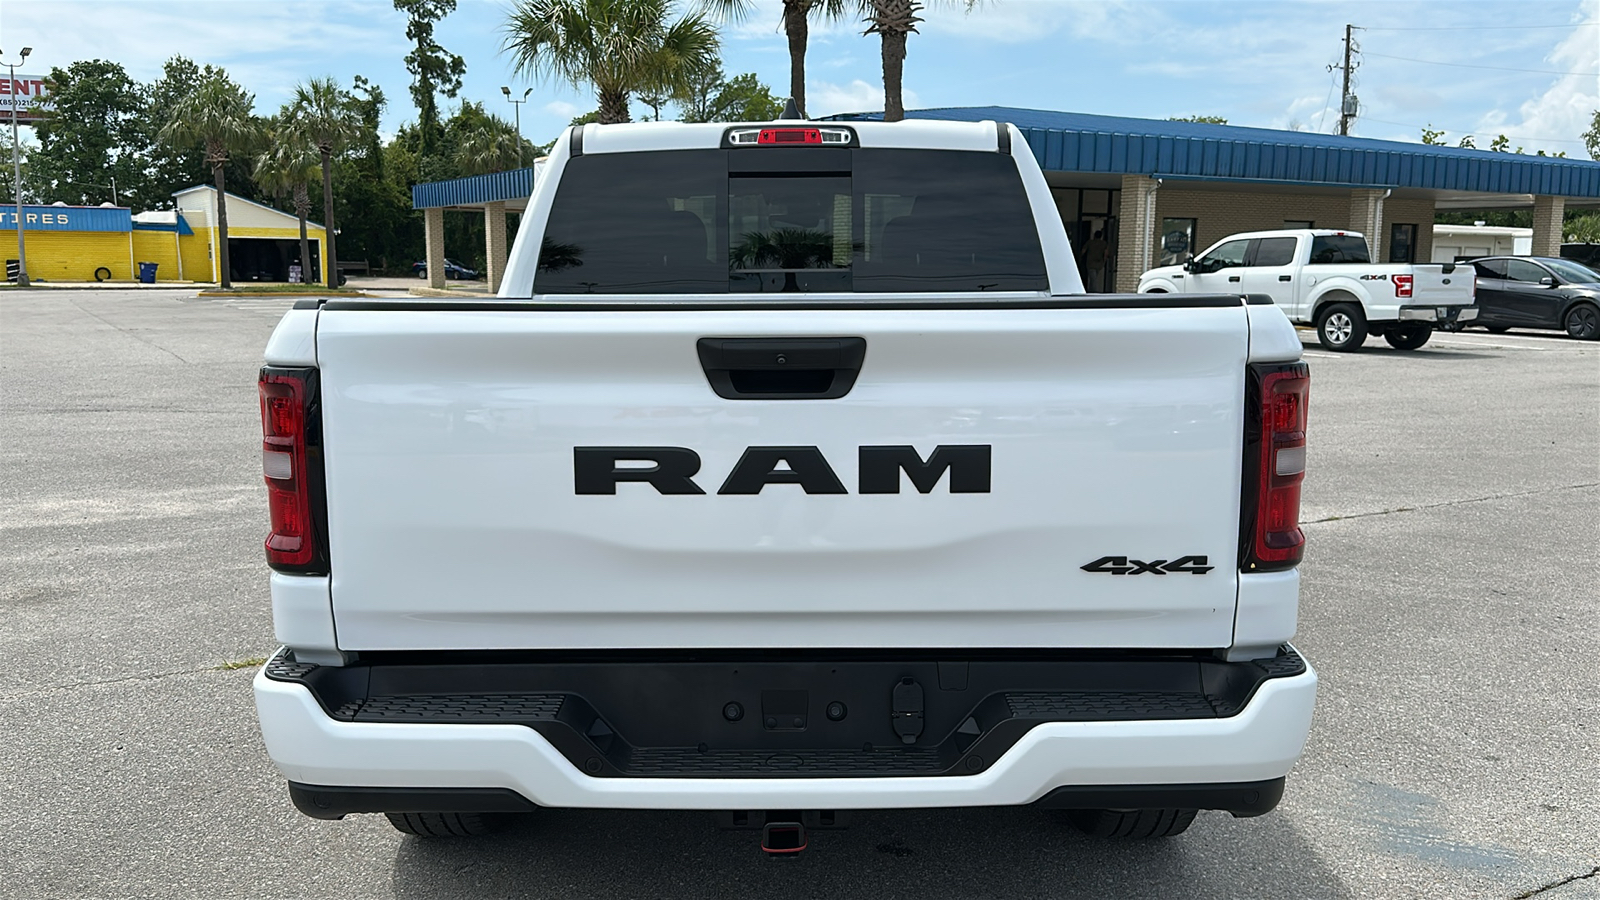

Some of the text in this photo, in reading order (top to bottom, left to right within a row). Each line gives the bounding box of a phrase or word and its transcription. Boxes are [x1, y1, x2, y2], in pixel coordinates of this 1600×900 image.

[0, 79, 57, 96] ENT
[573, 444, 992, 496] RAM
[1079, 555, 1216, 576] 4x4
